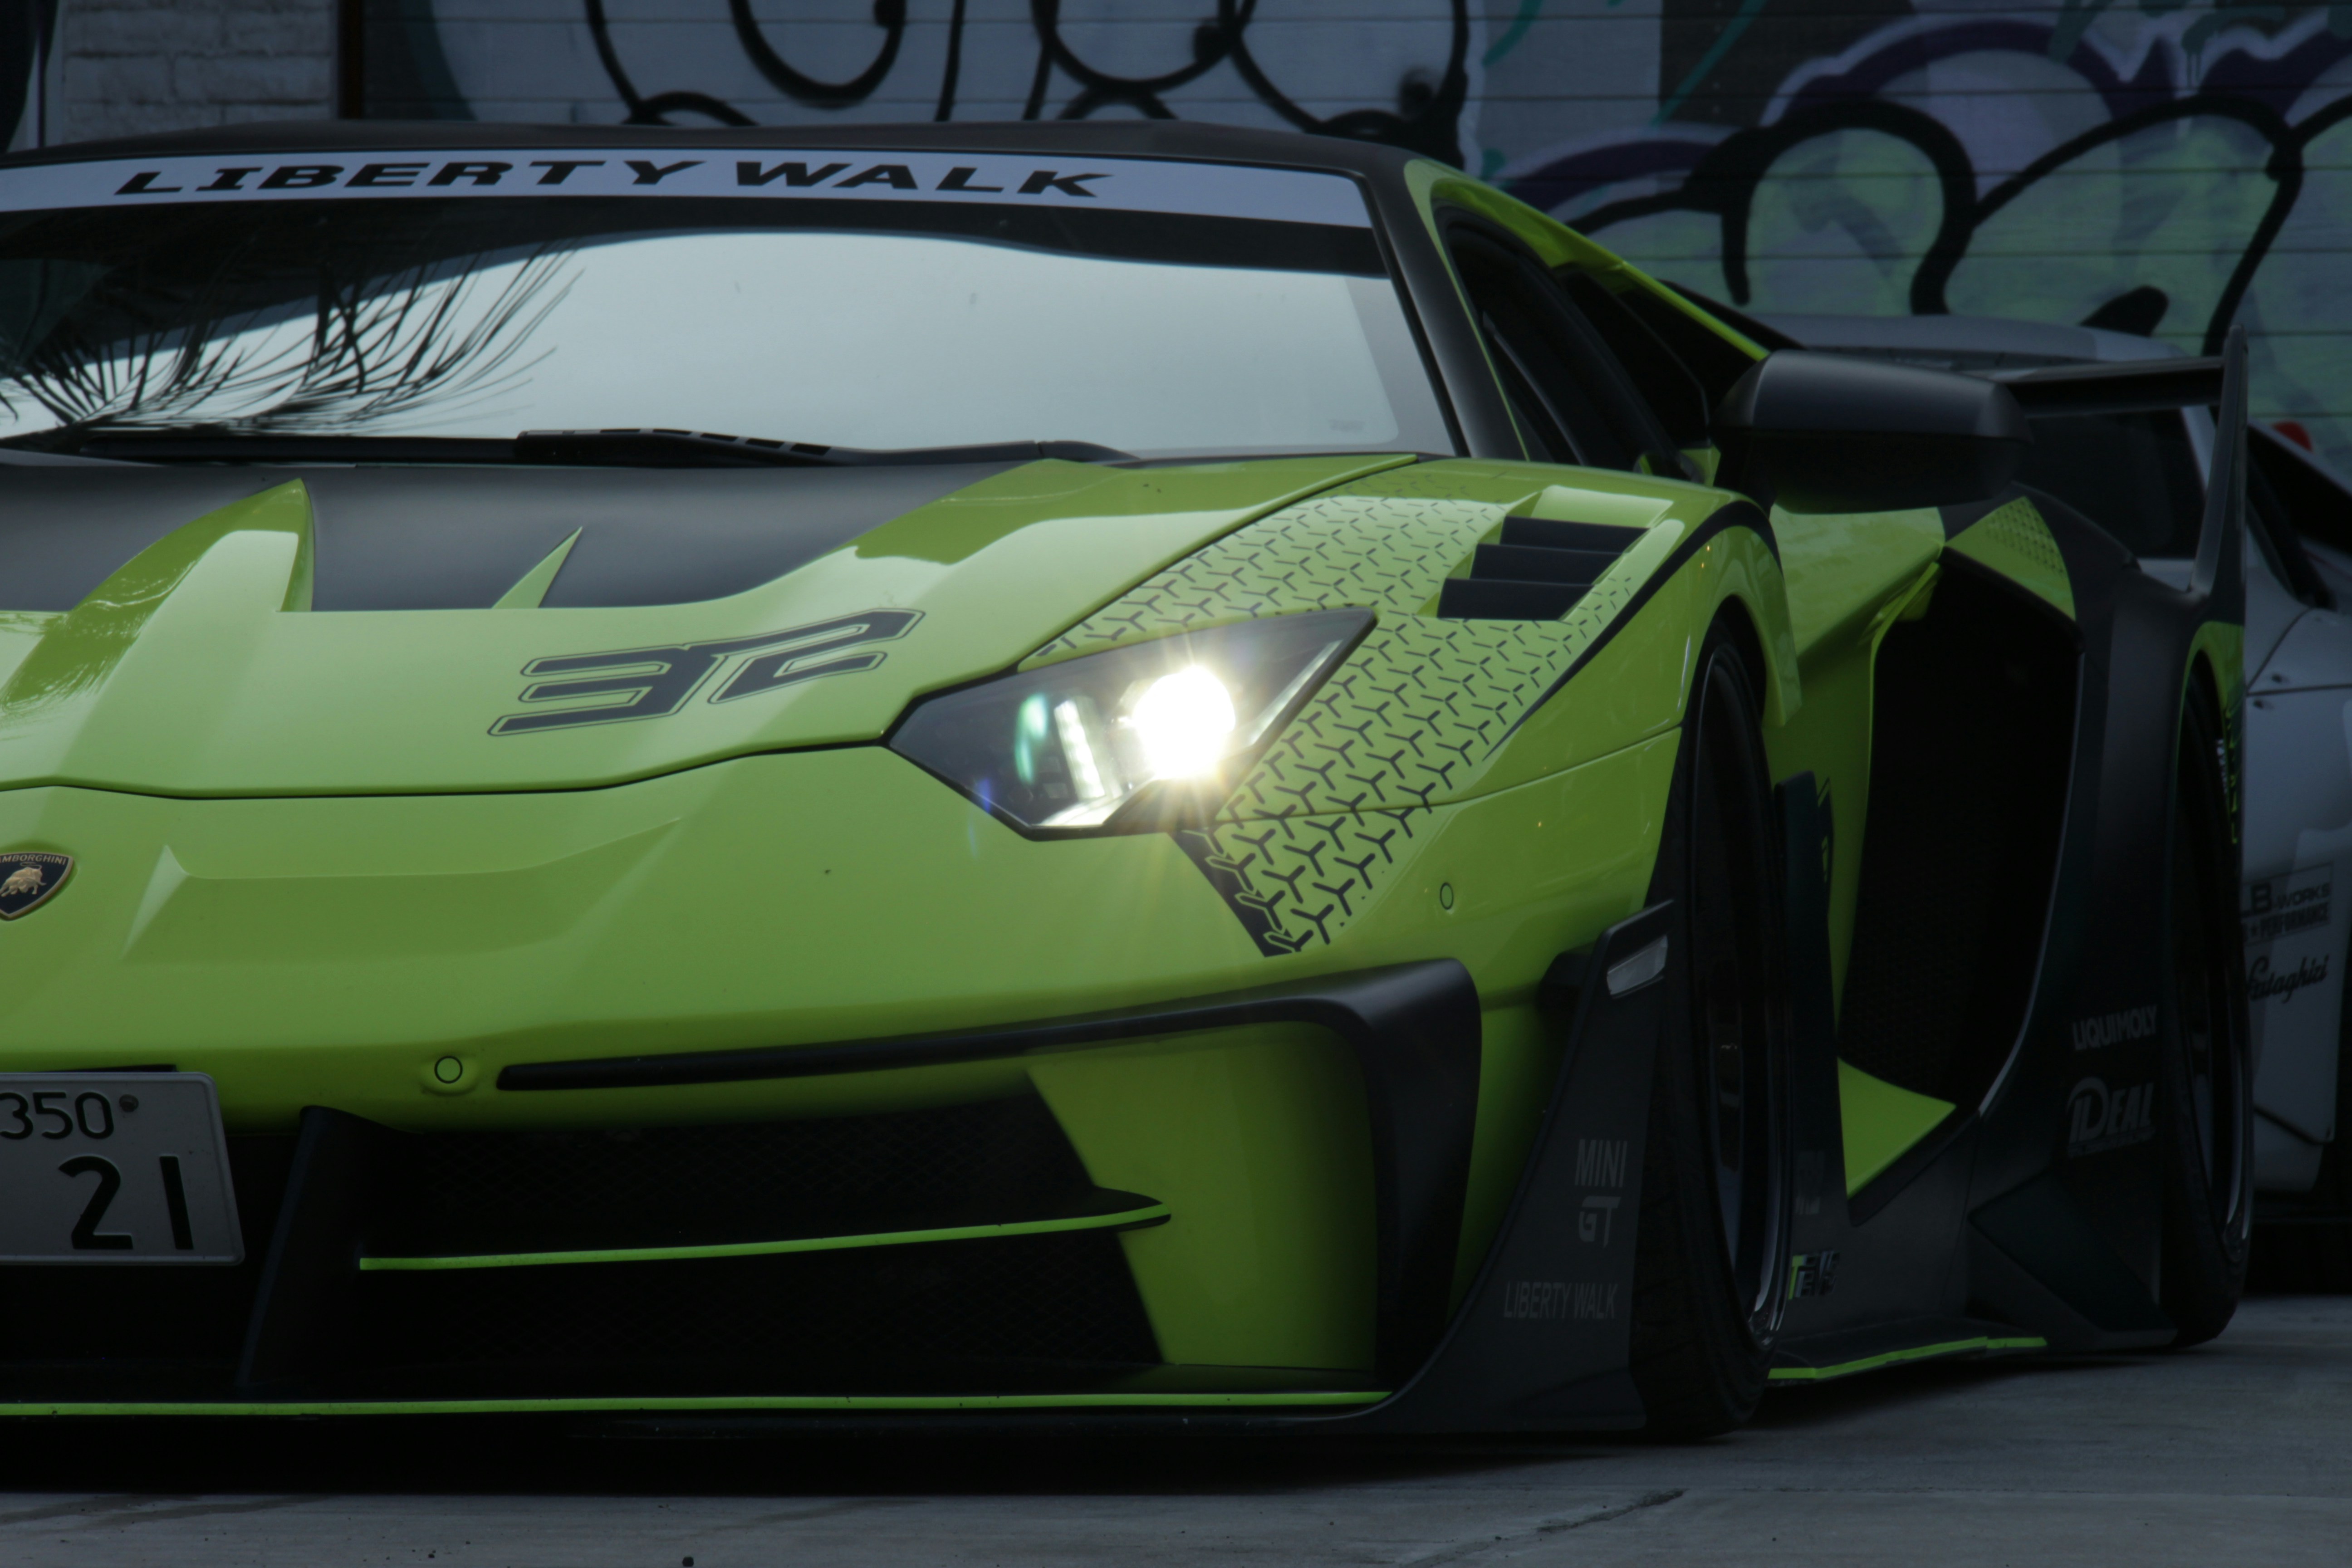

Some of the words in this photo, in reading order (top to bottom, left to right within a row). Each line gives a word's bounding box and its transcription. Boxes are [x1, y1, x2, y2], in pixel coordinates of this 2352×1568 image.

[113, 160, 707, 195] LIBERTY
[736, 162, 1114, 198] WALK
[0, 854, 67, 866] MBORGHINI
[0, 1092, 114, 1139] 350
[1574, 1139, 1627, 1188] MINI
[58, 1156, 194, 1250] 21
[1578, 1196, 1622, 1249] GT
[1503, 1281, 1573, 1318] LIBERTY
[1573, 1283, 1618, 1319] WALK
